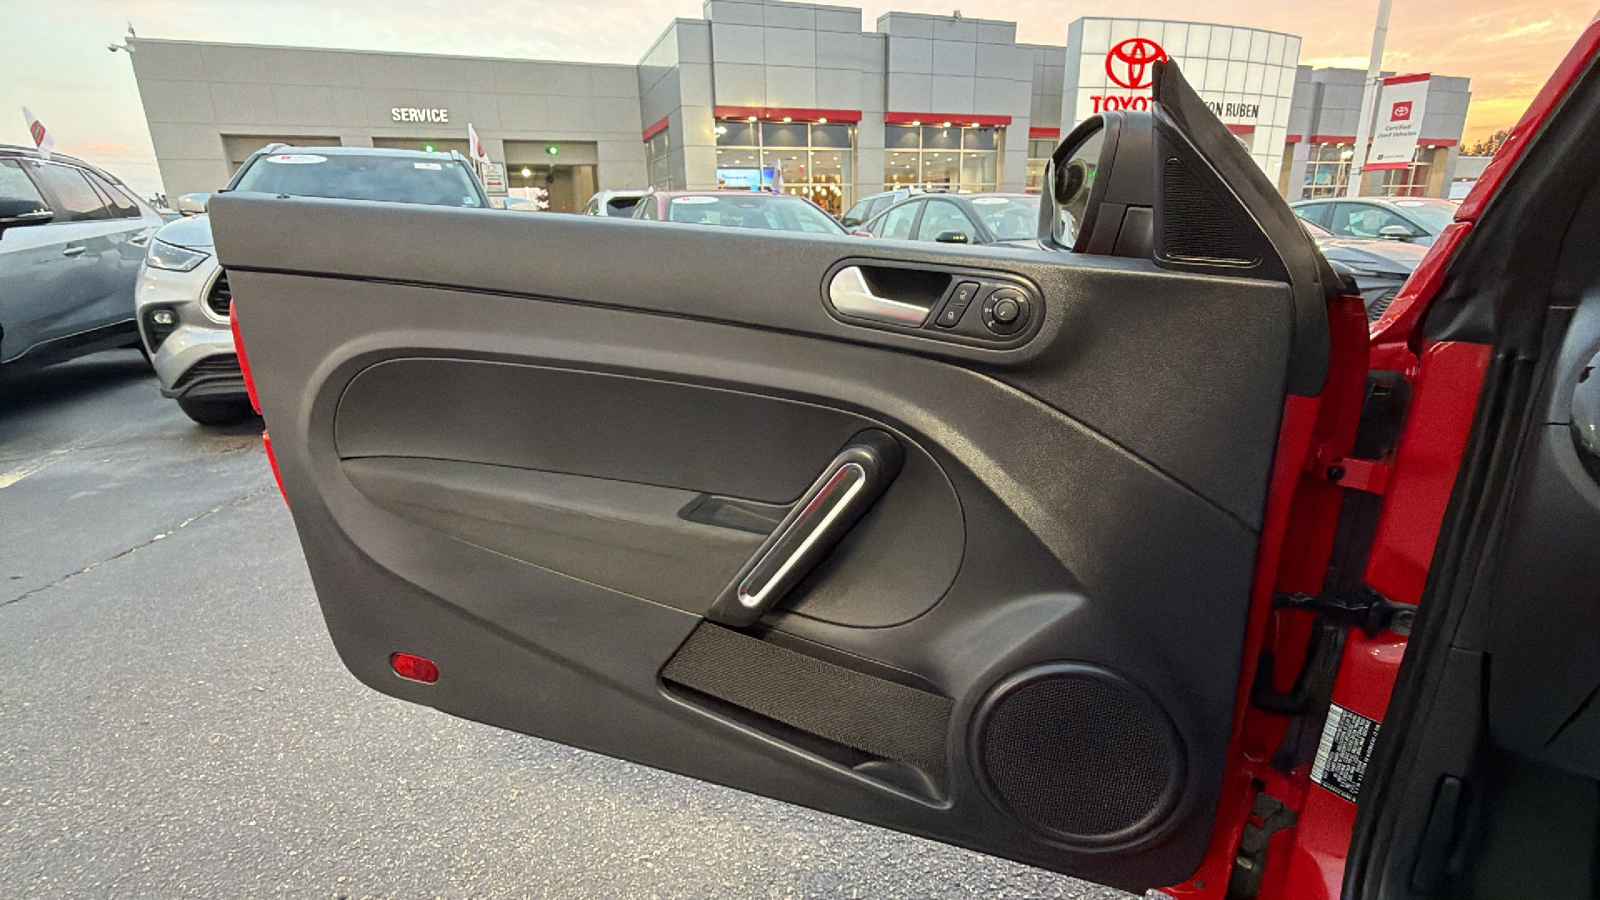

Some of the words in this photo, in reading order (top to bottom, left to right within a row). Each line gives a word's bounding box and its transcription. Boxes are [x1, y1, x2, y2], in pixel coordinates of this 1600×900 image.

[391, 107, 449, 122] SERVICE
[1204, 101, 1224, 117] ON
[1225, 102, 1259, 118] RUBEN
